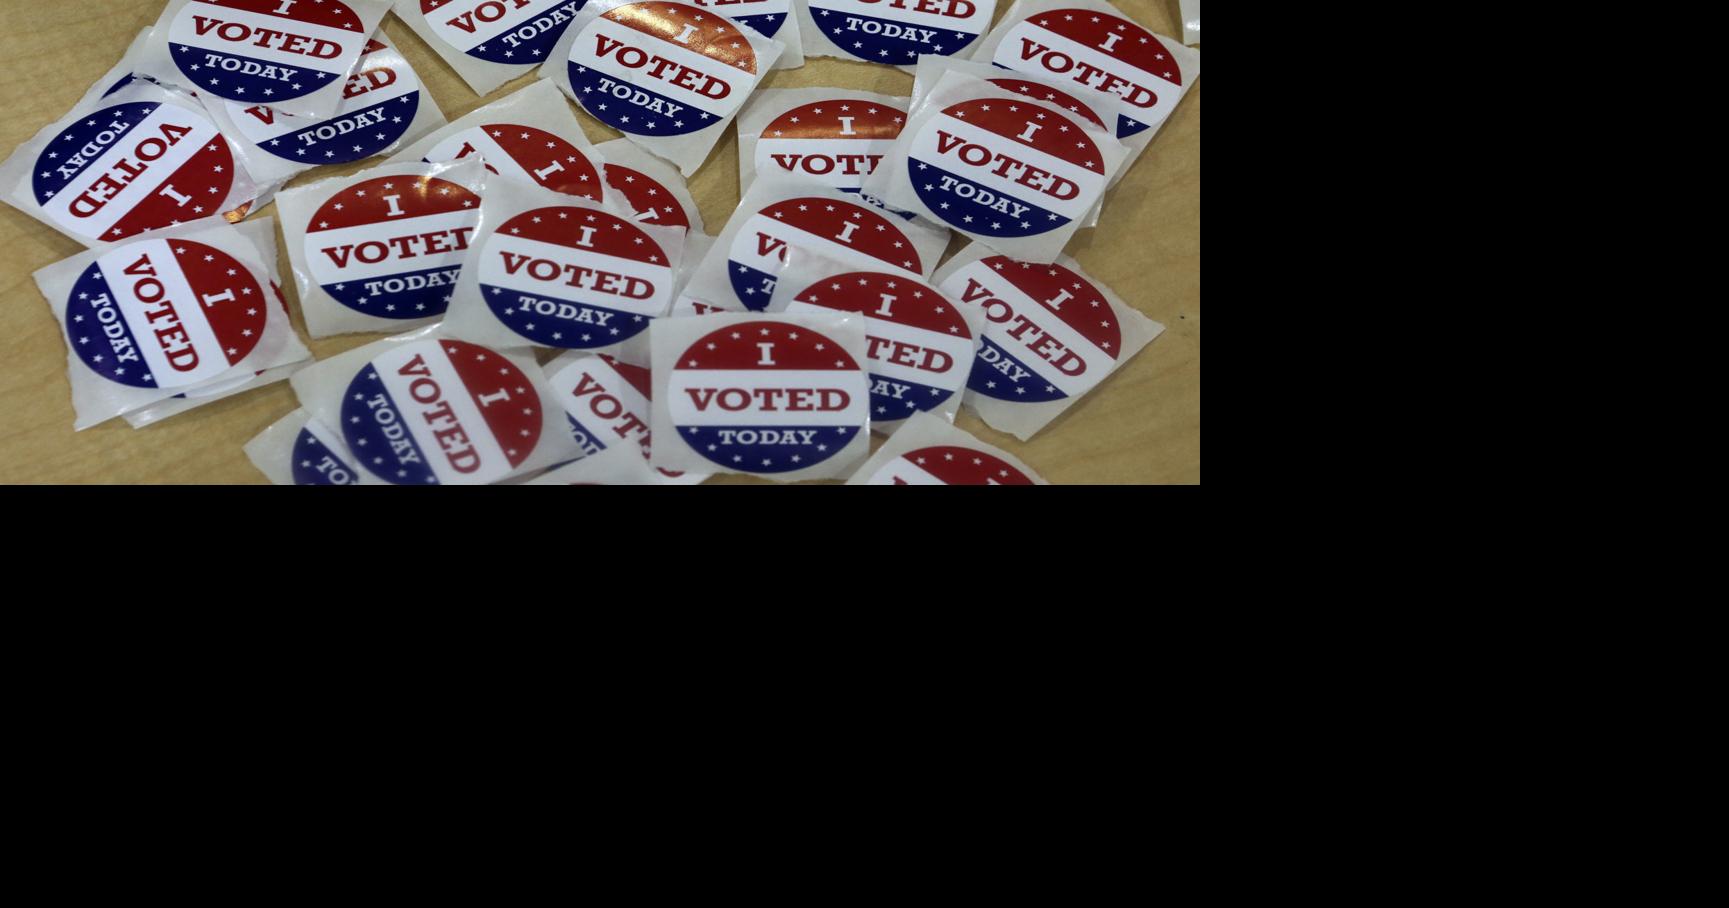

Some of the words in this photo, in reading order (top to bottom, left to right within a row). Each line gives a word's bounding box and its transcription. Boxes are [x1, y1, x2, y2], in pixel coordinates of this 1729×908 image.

[192, 15, 343, 60] VOTED
[502, 1, 578, 48] TODAY
[673, 23, 699, 44] I
[846, 17, 937, 43] TODAY
[1099, 32, 1123, 52] I
[204, 54, 298, 83] TODAY
[594, 34, 731, 100] VOTED
[1020, 37, 1158, 108] VOTED
[598, 78, 683, 119] TODAY
[298, 107, 386, 147] TODAY
[838, 117, 856, 135] I
[1017, 120, 1043, 143] I
[57, 120, 130, 180] TODAY
[69, 122, 192, 219] VOTED
[534, 160, 566, 181] I
[937, 130, 1080, 200] VOTED
[160, 184, 191, 208] I
[383, 195, 405, 216] I
[940, 175, 1030, 219] TODAY
[576, 226, 597, 247] I
[835, 221, 860, 243] I
[365, 270, 460, 296] TODAY
[500, 251, 655, 300] VOTED
[202, 288, 236, 308] I
[519, 296, 614, 327] TODAY
[875, 293, 897, 317] I
[1045, 288, 1075, 310] I
[123, 253, 199, 372] VOTED
[90, 293, 138, 363] TODAY
[961, 278, 1087, 376] VOTED
[757, 342, 775, 365] I
[478, 387, 510, 407] I
[685, 388, 850, 412] VOTED
[398, 353, 481, 474] VOTED
[368, 393, 421, 466] TODAY
[719, 430, 817, 445] TODAY
